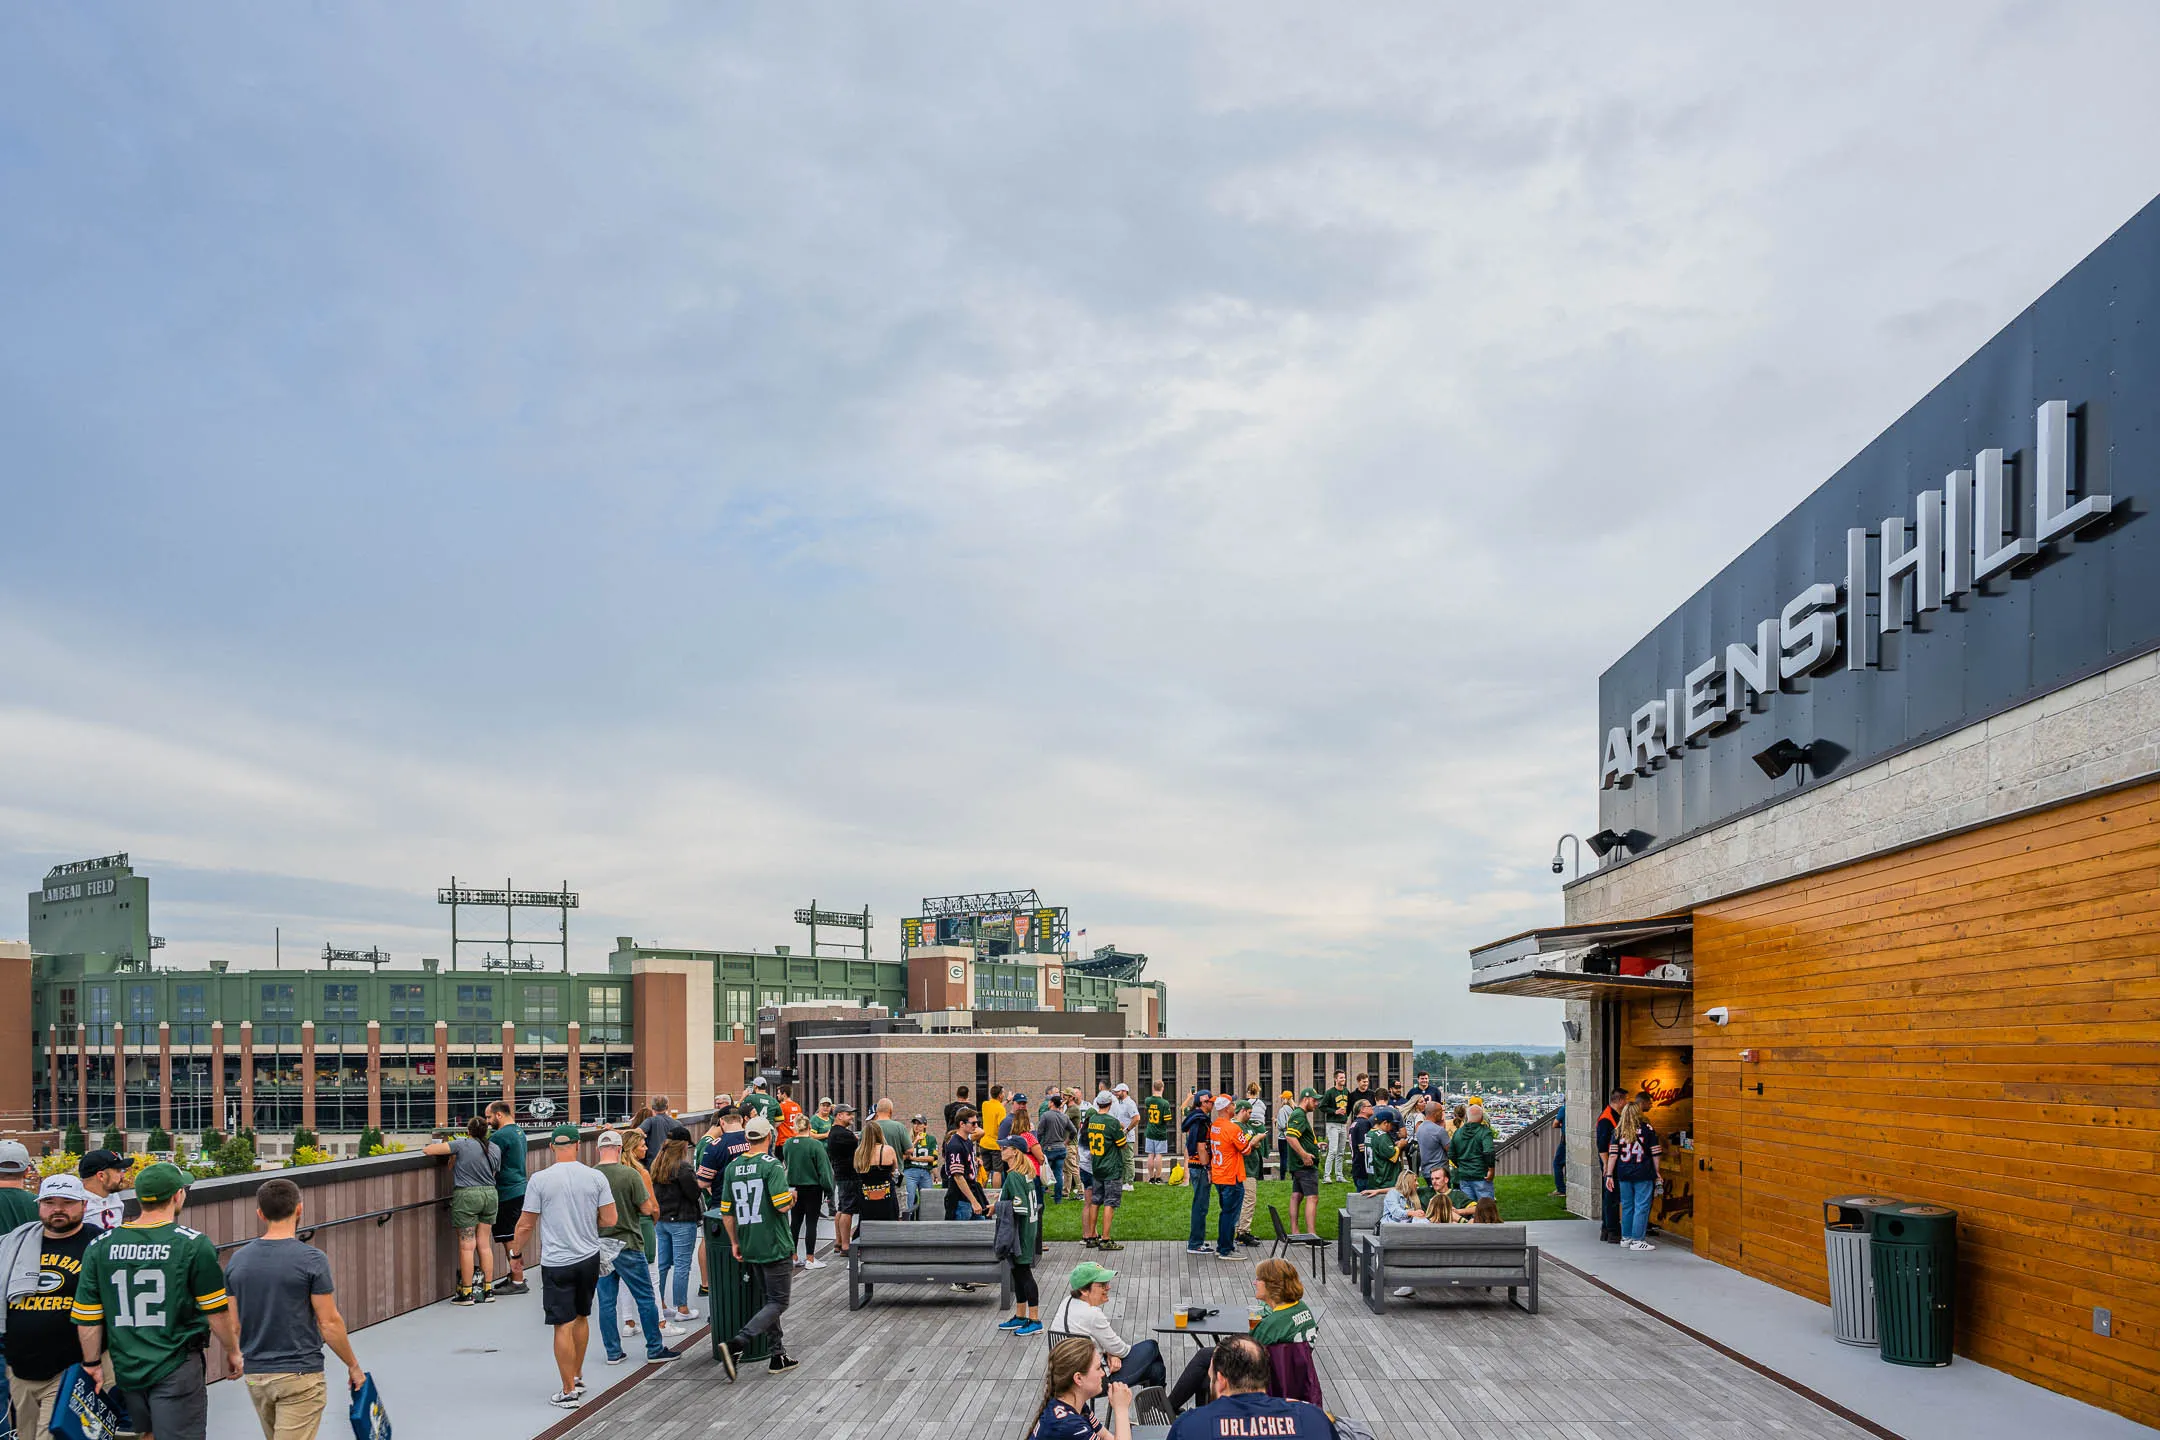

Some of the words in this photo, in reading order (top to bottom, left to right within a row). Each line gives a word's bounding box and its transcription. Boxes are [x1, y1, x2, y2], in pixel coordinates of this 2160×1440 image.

[1600, 583, 1837, 790] ARIENS
[1880, 400, 2111, 634] HILL
[43, 884, 81, 902] LAMBEAU
[87, 879, 115, 896] FIELD
[931, 898, 985, 912] LAMBEAU
[989, 894, 1023, 909] FIELD
[728, 1143, 751, 1155] TRUBIS
[1088, 1132, 1105, 1156] 23
[1619, 1137, 1645, 1163] 34
[950, 1153, 961, 1165] 34
[735, 1164, 757, 1176] NELSON
[731, 1178, 764, 1225] 87
[109, 1244, 171, 1260] RODGERS
[111, 1269, 166, 1328] 12
[1292, 1310, 1312, 1326] RODGERS
[1219, 1416, 1297, 1437] URLACHER
